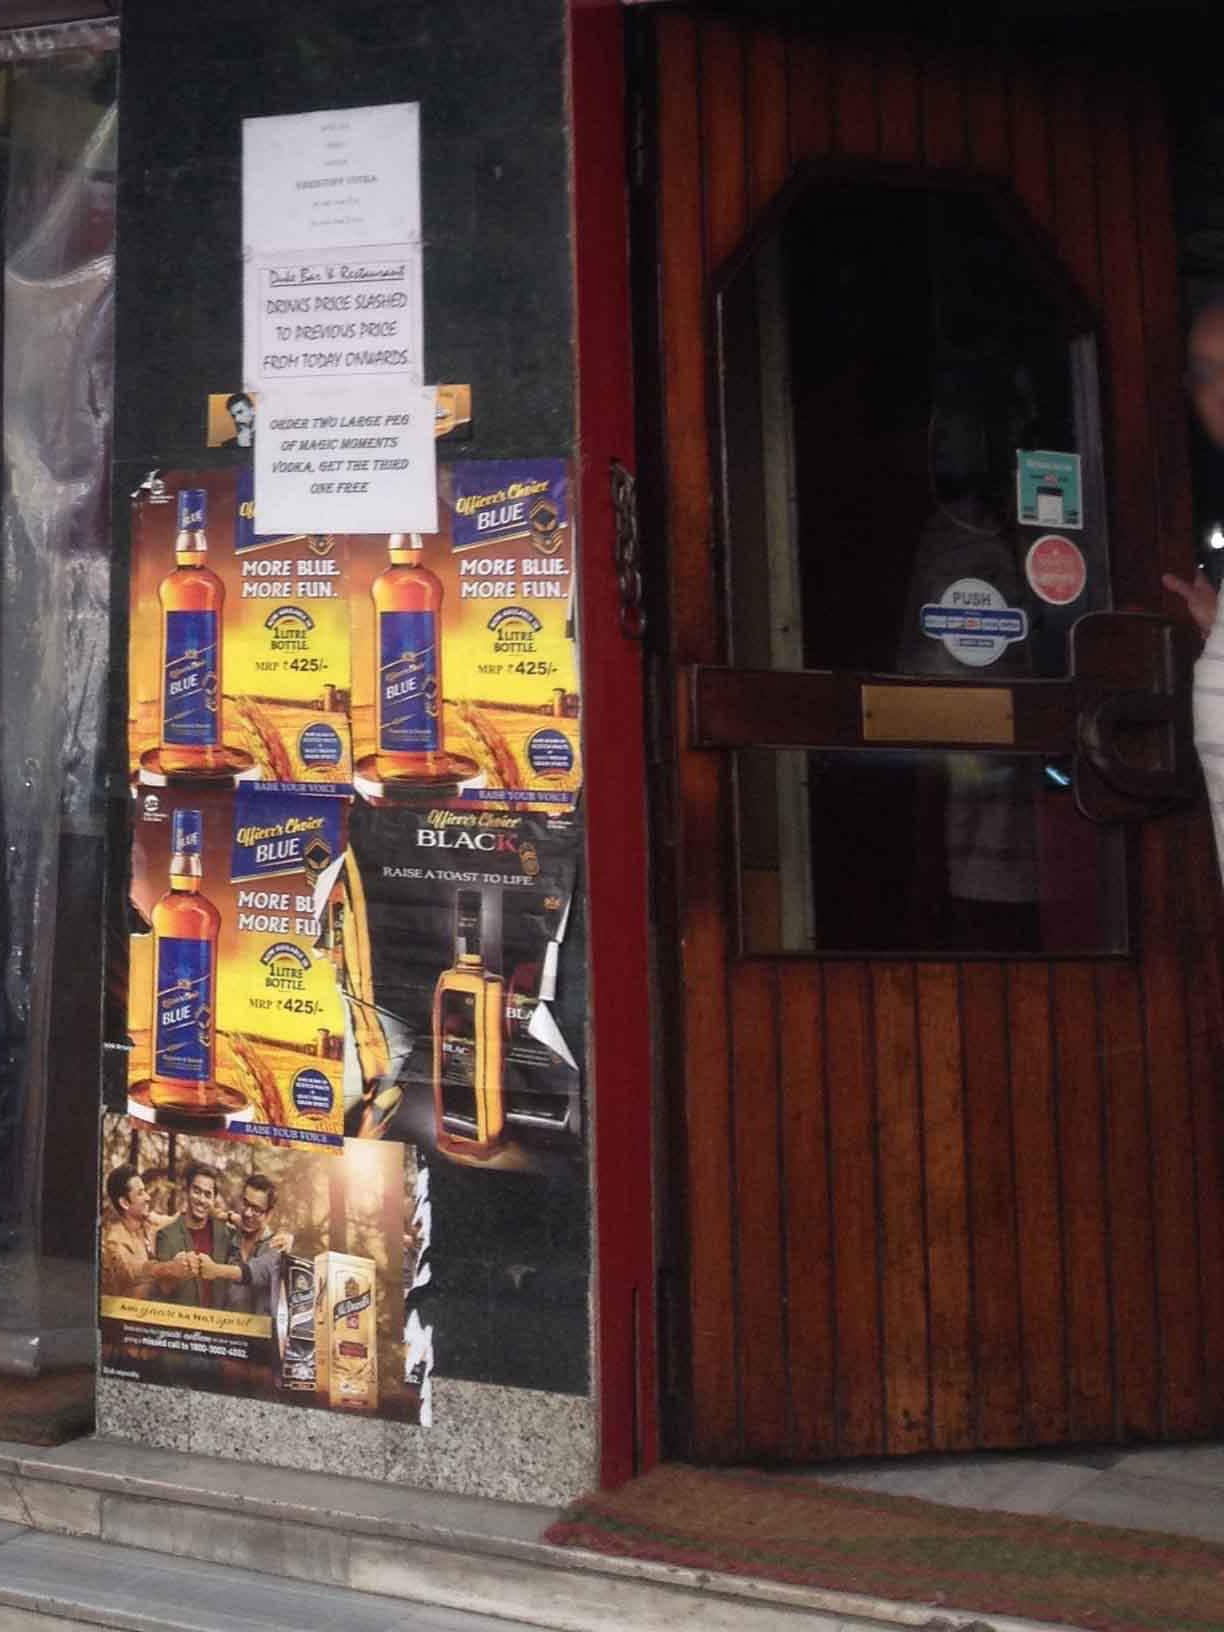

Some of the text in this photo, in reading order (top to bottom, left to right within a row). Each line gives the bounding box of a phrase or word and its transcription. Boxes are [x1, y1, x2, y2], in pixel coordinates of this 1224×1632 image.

[266, 292, 408, 314] DRINKS PRICE SLASHED
[275, 321, 398, 341] TO PREVIOUS PRICE
[264, 352, 300, 369] FROM
[301, 351, 343, 368] TODAY
[269, 413, 411, 430] ORDER TWO LARGE PEG
[280, 437, 398, 451] OF MAGIC MOMENTS
[318, 460, 344, 472] GET
[346, 459, 370, 471] THE
[373, 459, 410, 471] THIRD
[310, 481, 370, 494] ONE FREE
[456, 479, 551, 516] Officer's Choice
[476, 501, 525, 531] BLUE
[241, 559, 341, 577] MORE BLUE.
[459, 558, 569, 576] MORE BLUE.
[241, 581, 339, 598] MORE FUN.
[460, 581, 569, 599] MORE FUN.
[951, 590, 993, 607] PUSH
[255, 661, 280, 672] MRP
[478, 663, 504, 674] MRP
[169, 674, 200, 696] BLUE
[385, 676, 417, 699] BLUE
[426, 809, 477, 829] Officer's
[236, 816, 325, 847] Officer's Choice
[416, 828, 521, 853] BLACK
[255, 837, 300, 863] BLUE
[382, 866, 537, 887] RAISE A TOAST TO LIFE.
[238, 891, 290, 912] MORE
[238, 913, 290, 934] MORE
[248, 998, 273, 1009] MRP
[162, 1003, 192, 1026] BLUE
